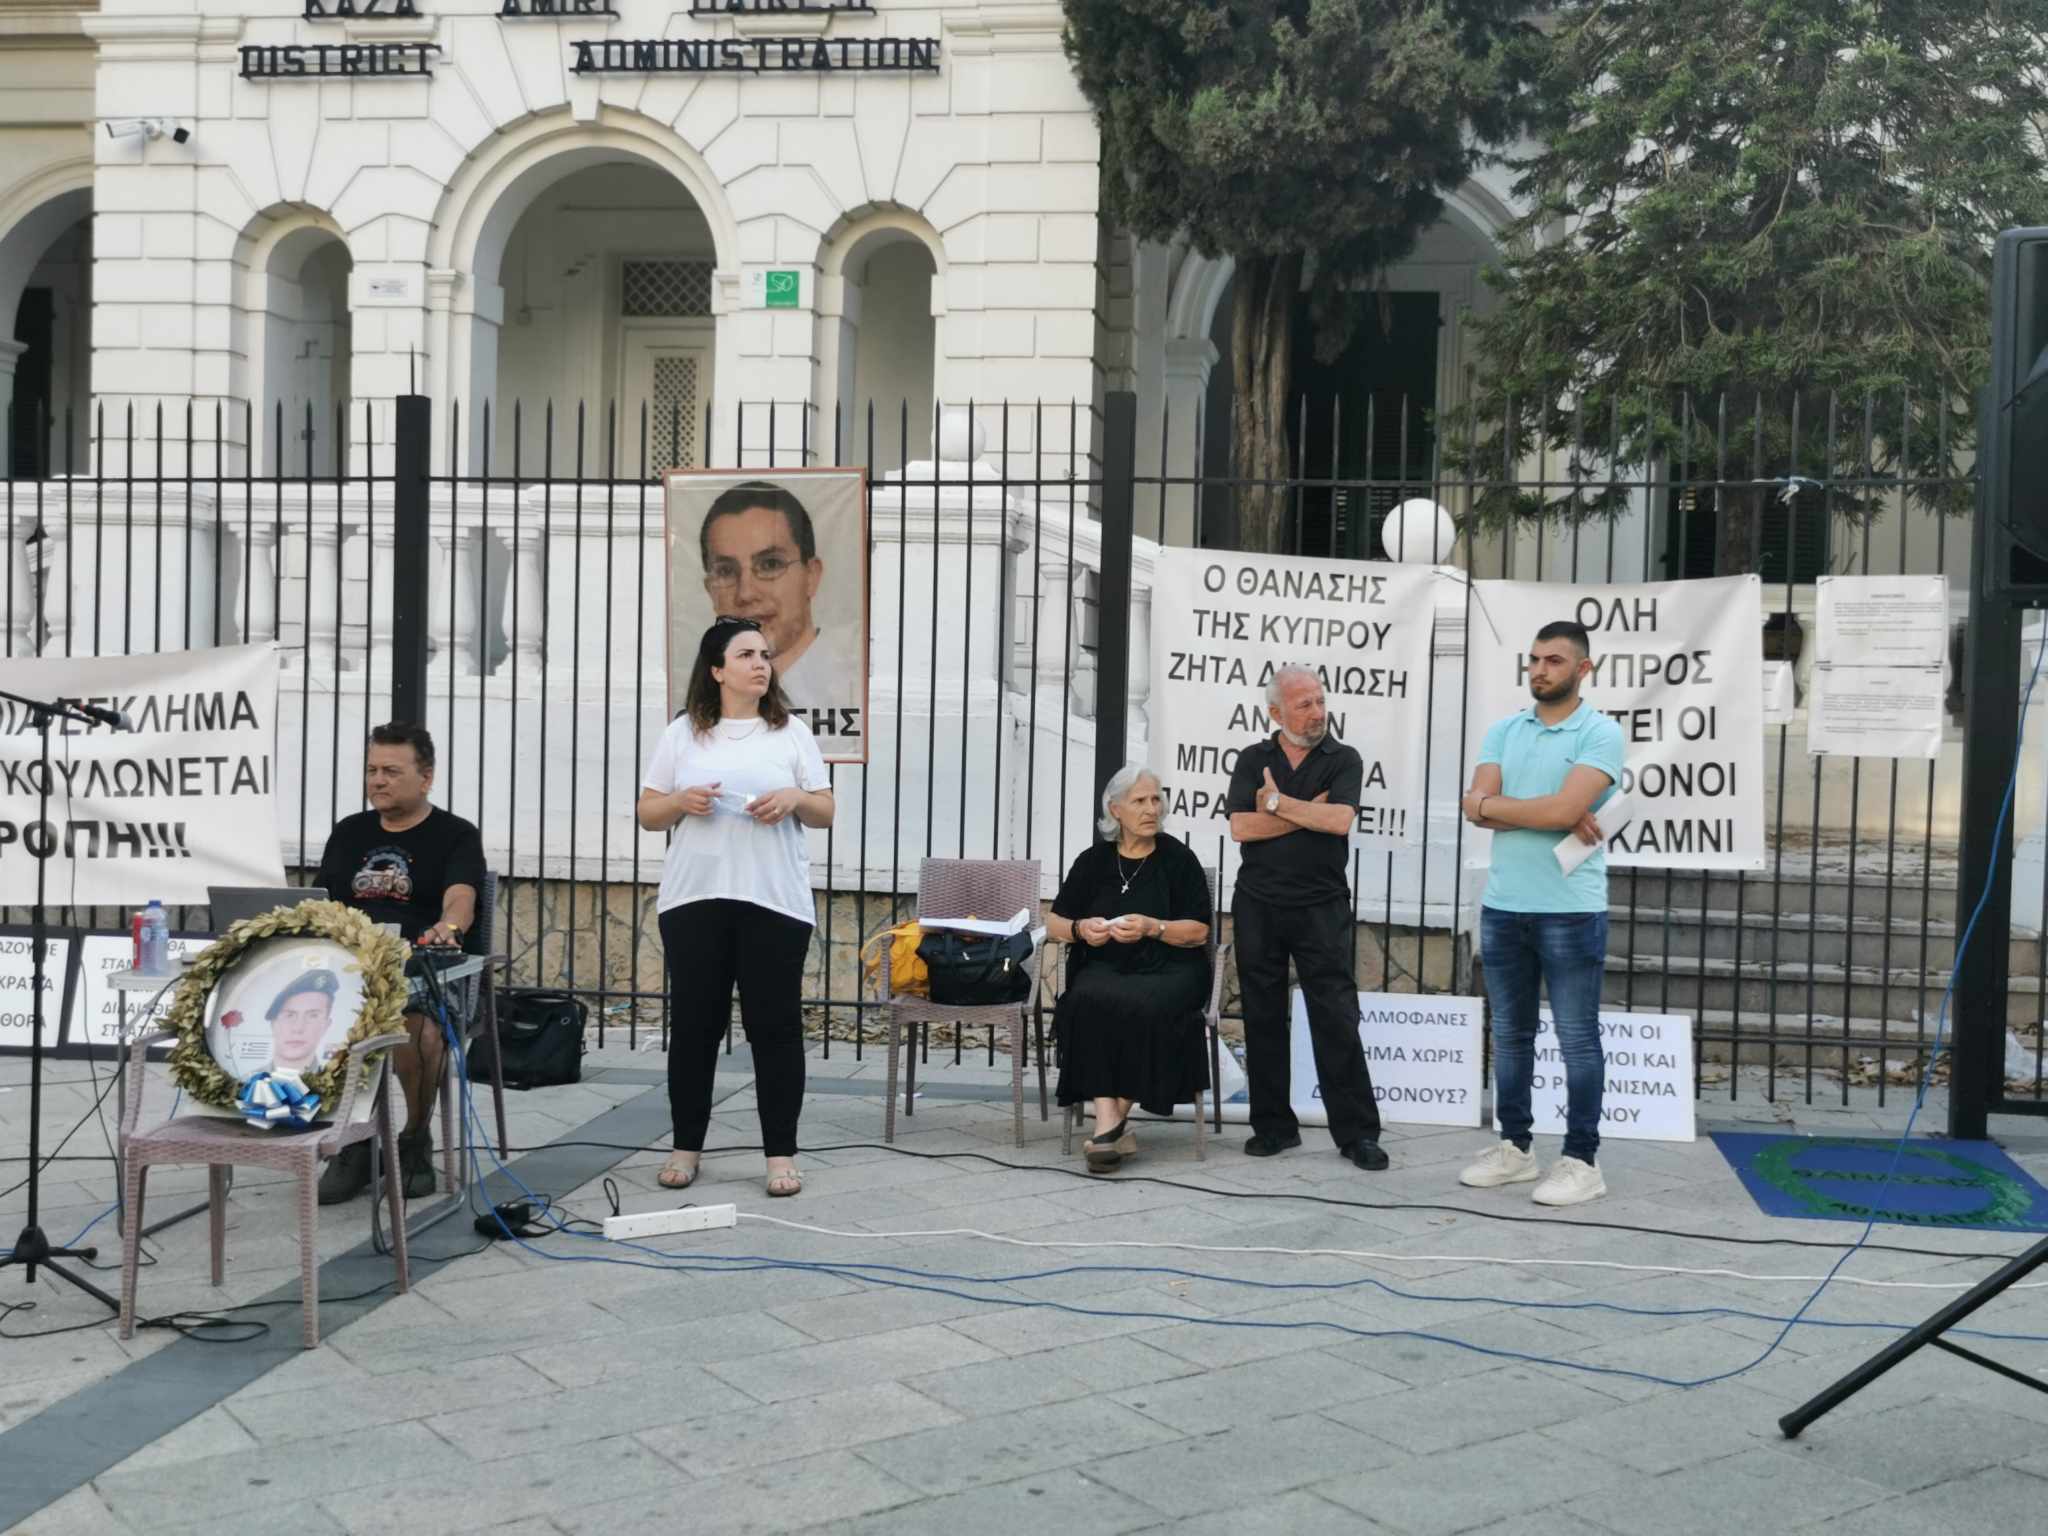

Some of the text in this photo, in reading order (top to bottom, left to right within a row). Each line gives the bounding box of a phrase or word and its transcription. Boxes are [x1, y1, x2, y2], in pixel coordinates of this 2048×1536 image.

[241, 38, 936, 77] DISTRICT ADMINISTRATION
[1203, 563, 1388, 605] Ο ΘΑΝΑΣΗΣ
[1192, 608, 1393, 651] ΤΗΣ ΚΥΠΡΟΥ
[1575, 596, 1658, 632] ΟΛΗ
[1167, 651, 1408, 700] ΖΗΤΑ ΔΑΙΩΣΗ
[1588, 650, 1713, 689] ΥΠΡΟΣ
[1677, 705, 1716, 741] ΟΙ
[1607, 818, 1734, 854] ΚΑΜΝΙ
[1639, 1024, 1661, 1040] ΟΙ
[1411, 1047, 1465, 1064] ΧΩΡΙΣ
[1643, 1052, 1676, 1069] ΚΑΙ
